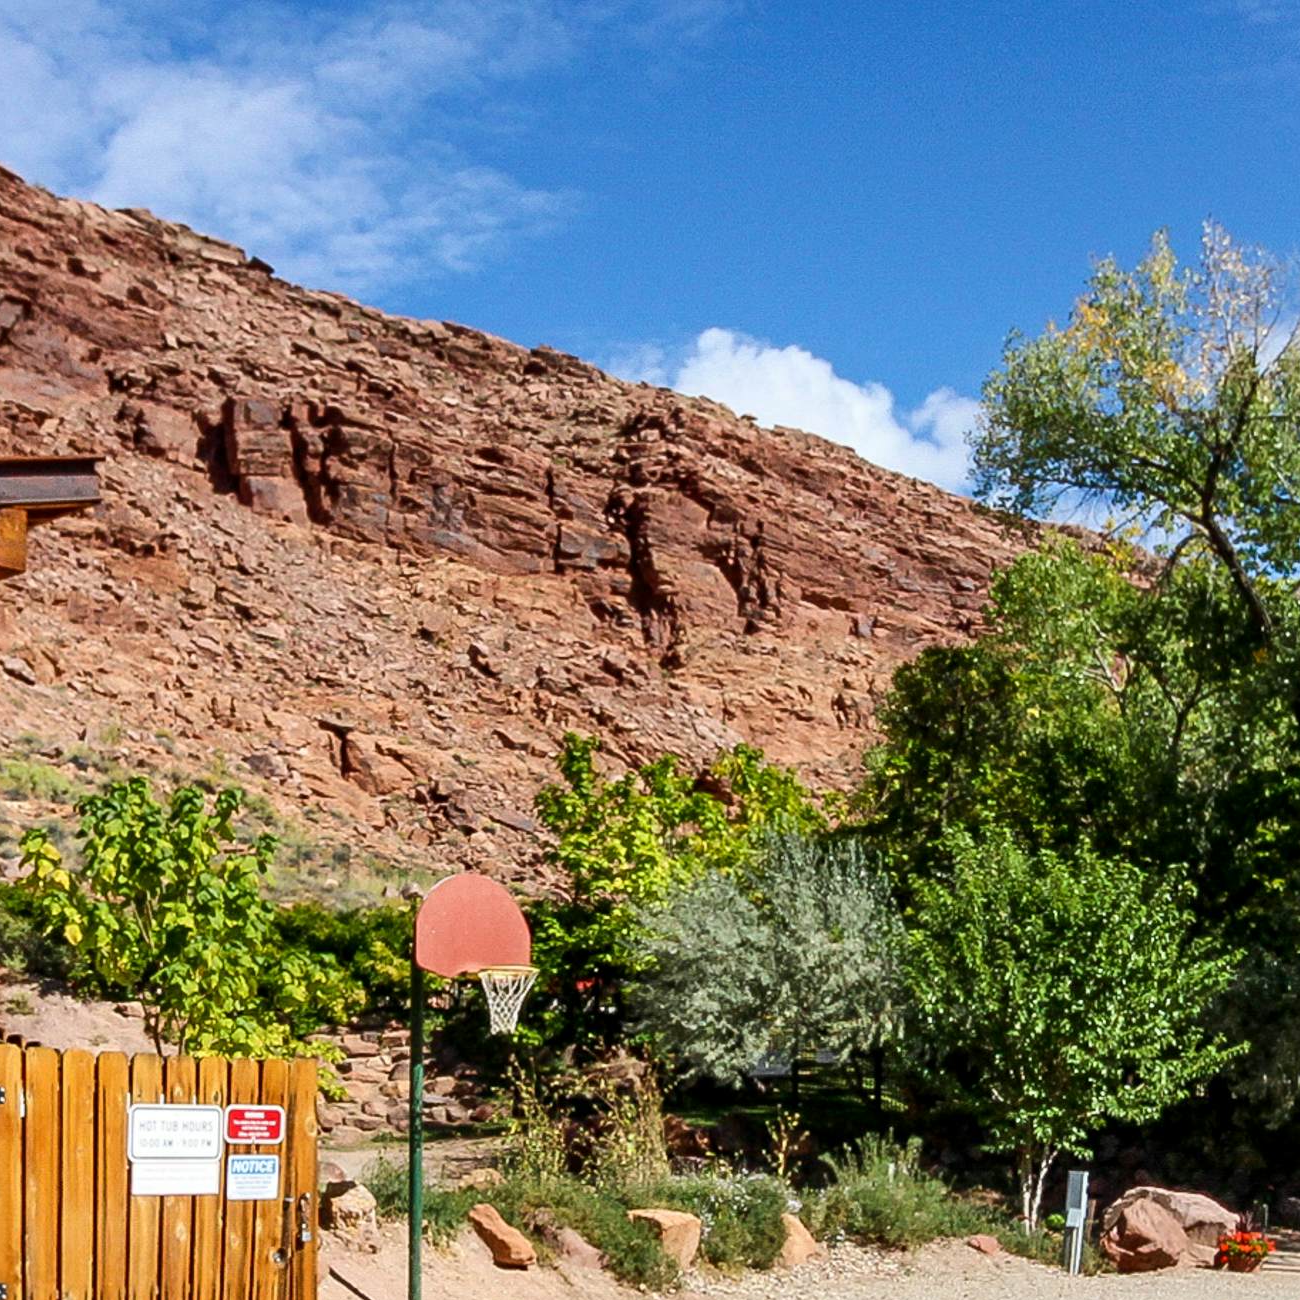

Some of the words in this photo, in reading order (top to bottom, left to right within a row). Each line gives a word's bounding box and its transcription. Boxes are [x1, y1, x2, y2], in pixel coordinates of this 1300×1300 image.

[140, 1119, 157, 1132] HOT
[160, 1119, 179, 1132] TUB
[182, 1119, 214, 1133] HOURS
[232, 1160, 274, 1174] NOTICE
